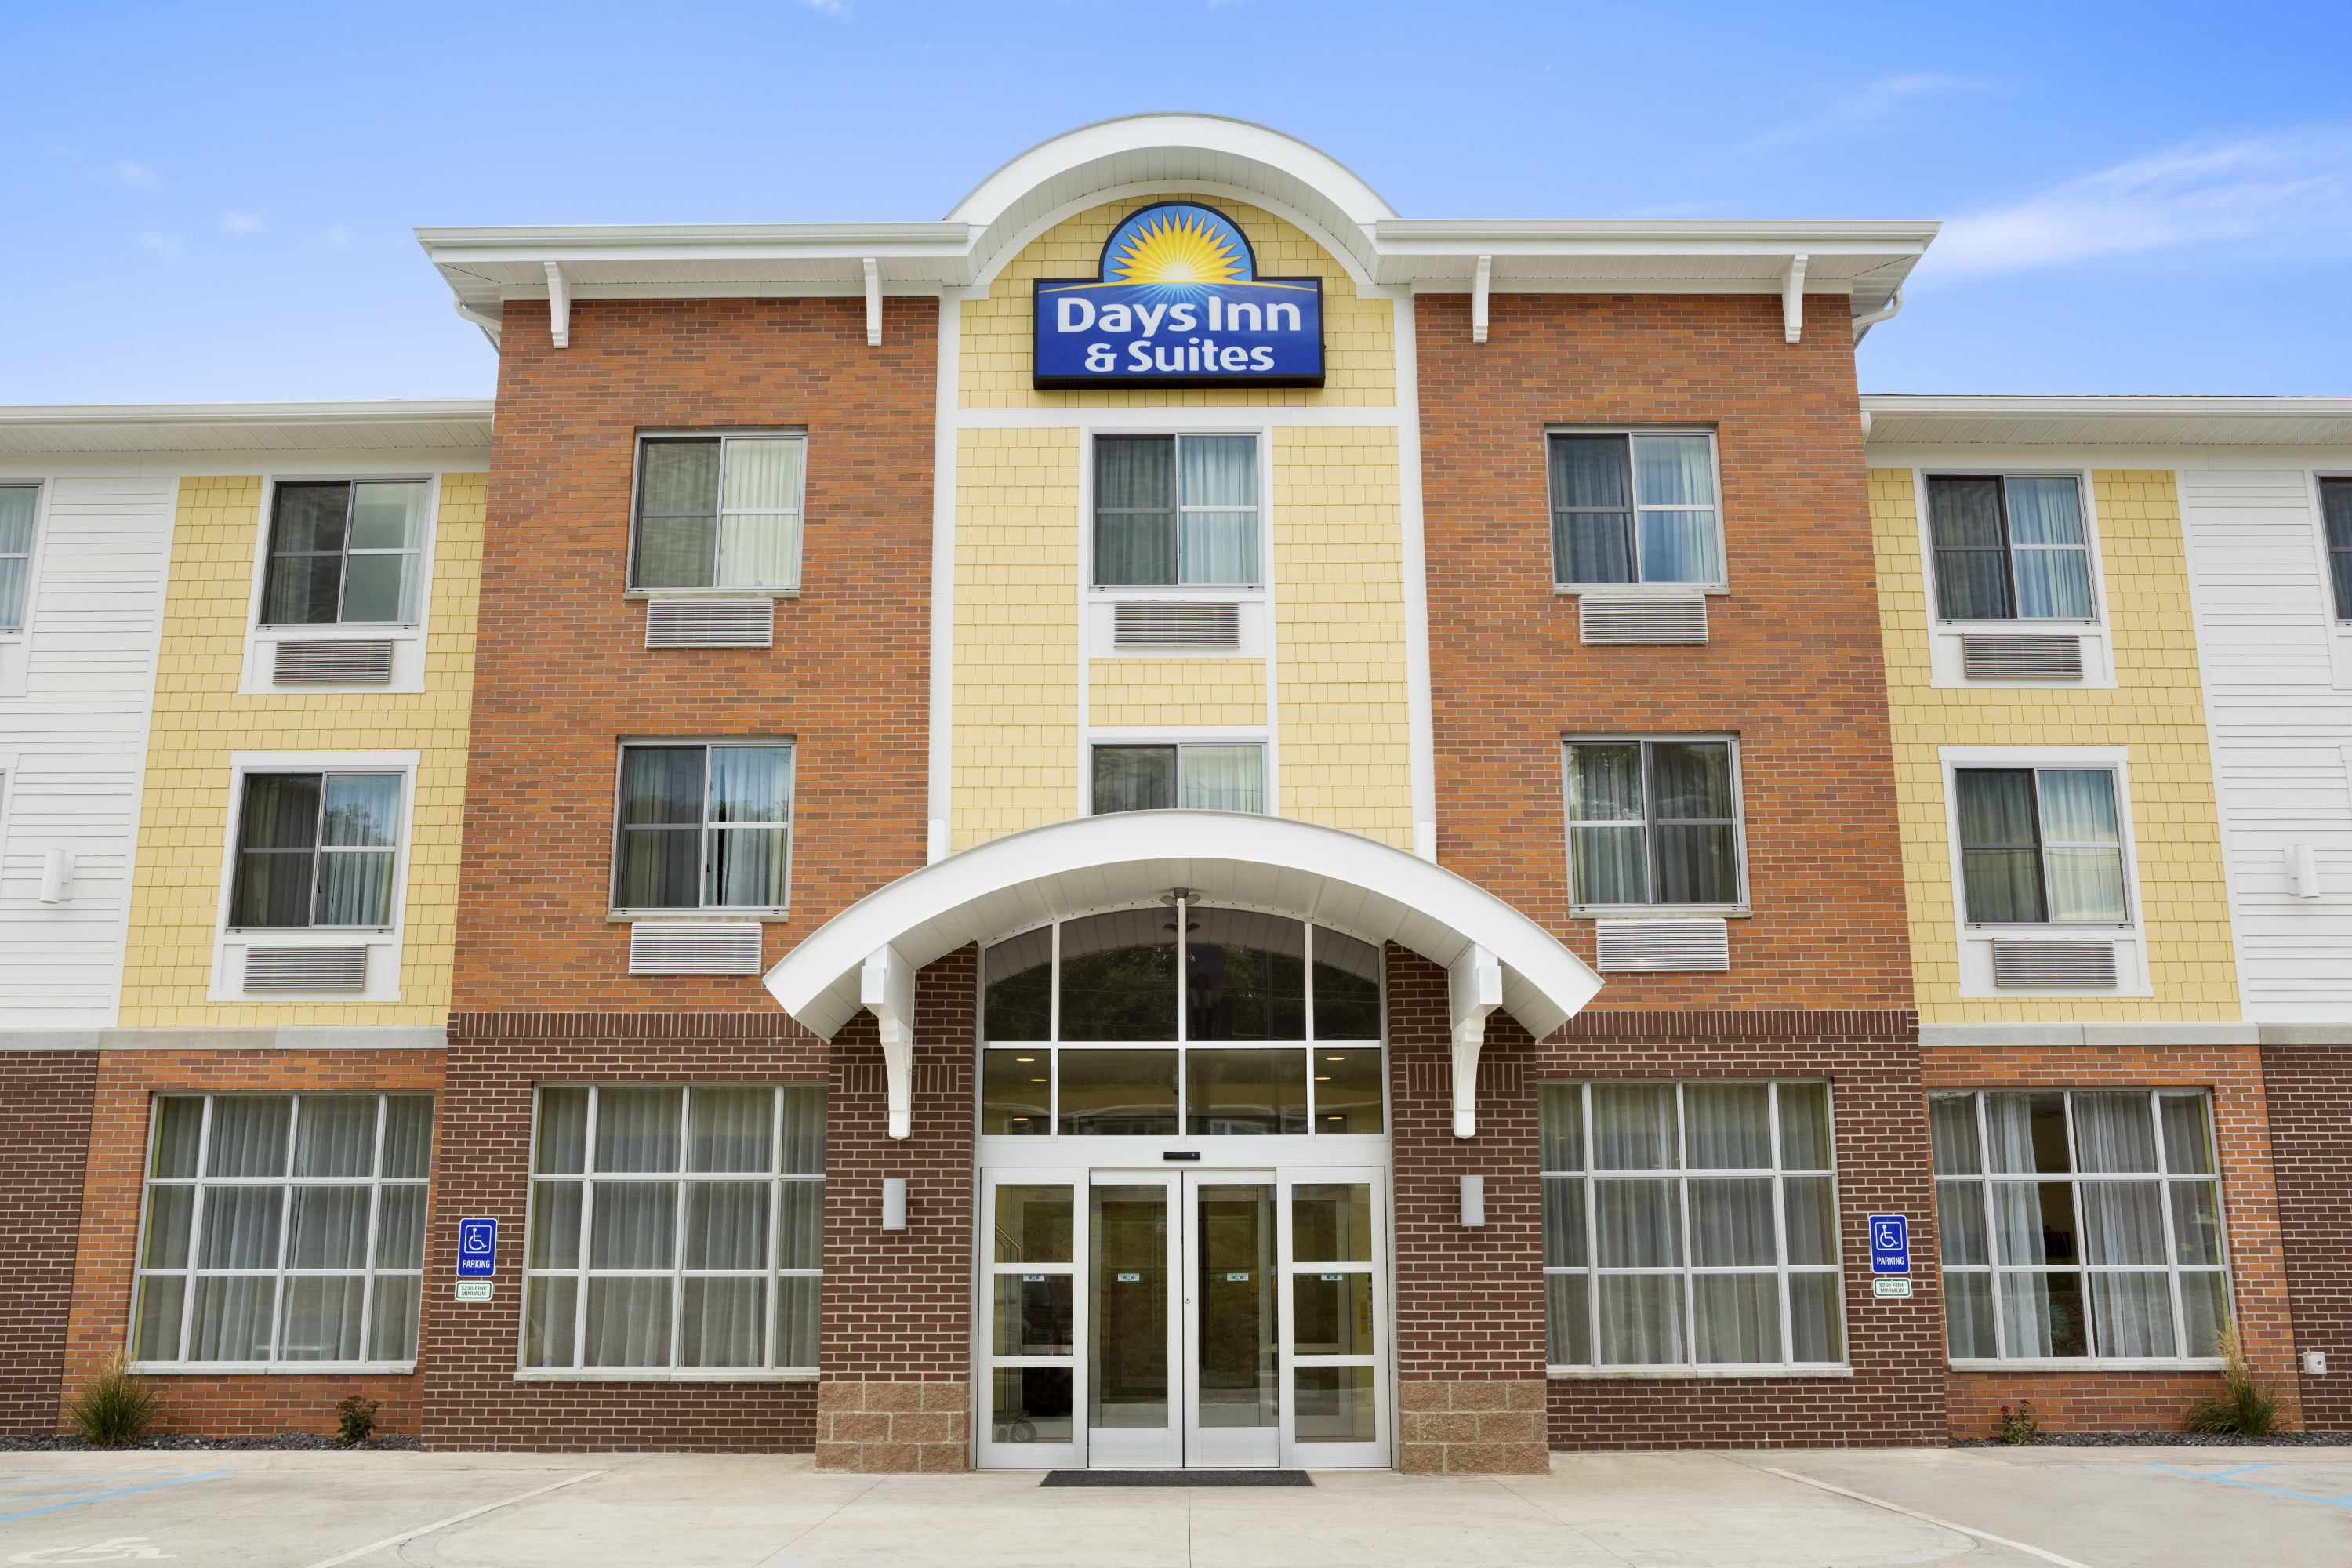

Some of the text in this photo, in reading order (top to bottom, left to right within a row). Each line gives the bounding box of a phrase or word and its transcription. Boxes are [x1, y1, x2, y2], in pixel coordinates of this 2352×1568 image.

[1058, 296, 1301, 338] Days Inn
[1084, 337, 1275, 372] & Suites
[463, 1259, 491, 1268] PARKING
[1876, 1256, 1904, 1265] PARKING
